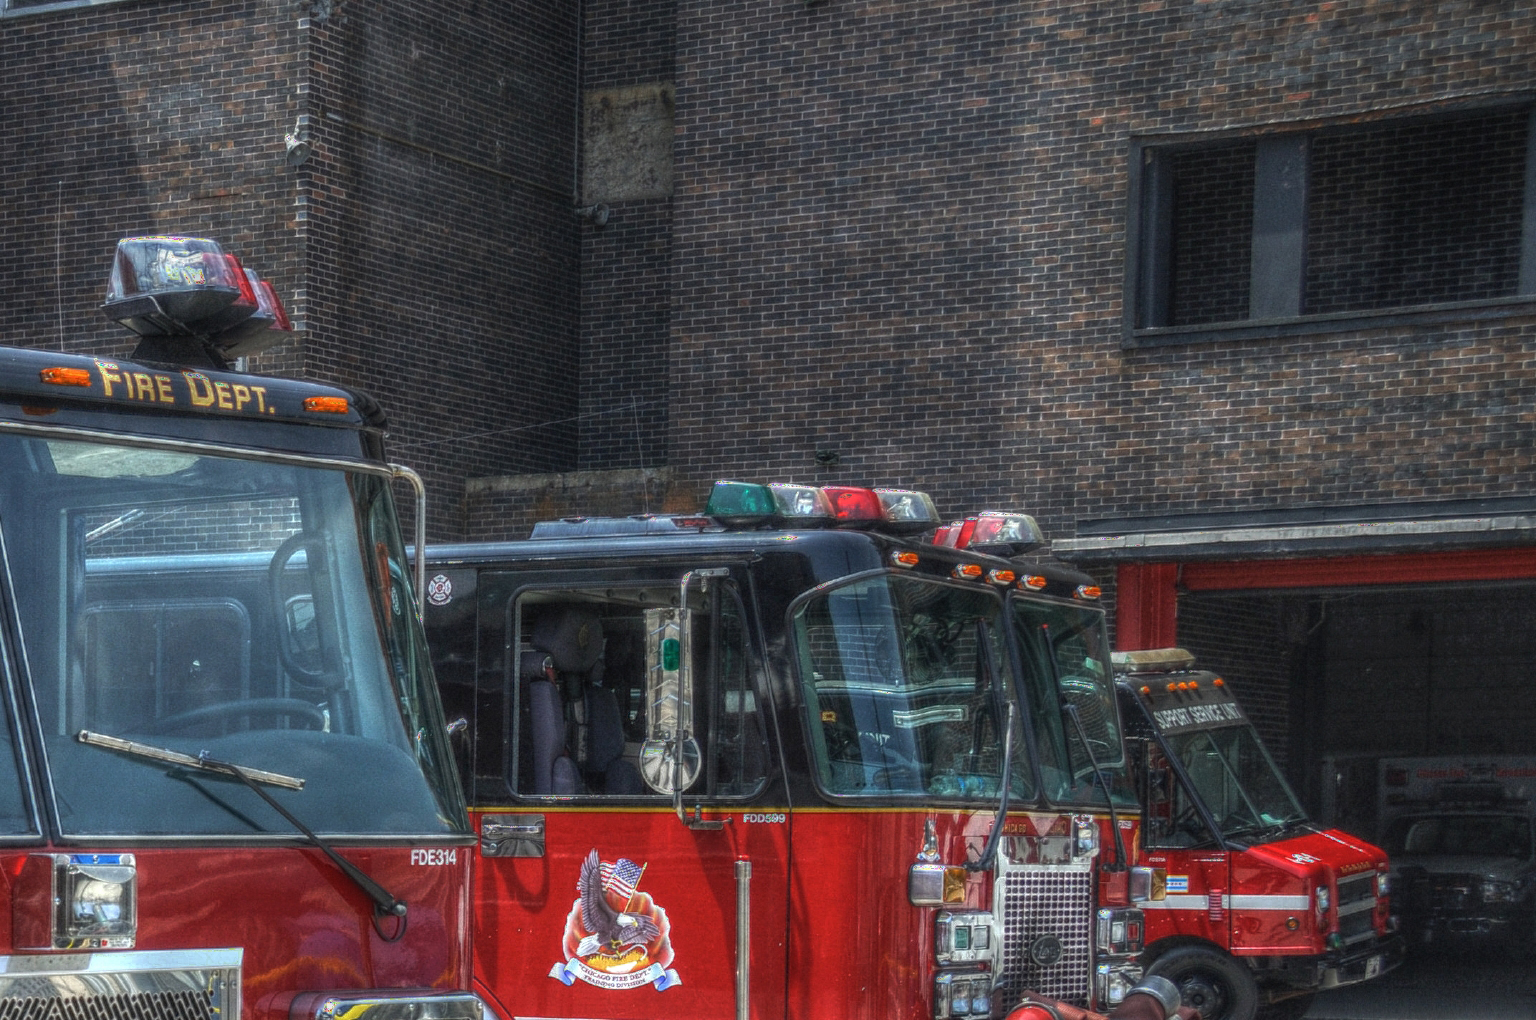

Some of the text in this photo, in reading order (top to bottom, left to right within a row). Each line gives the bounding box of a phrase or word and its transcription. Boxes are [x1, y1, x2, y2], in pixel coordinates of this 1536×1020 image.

[94, 357, 174, 403] FIRE
[180, 370, 275, 414] DEPT.
[410, 848, 457, 866] FDE314
